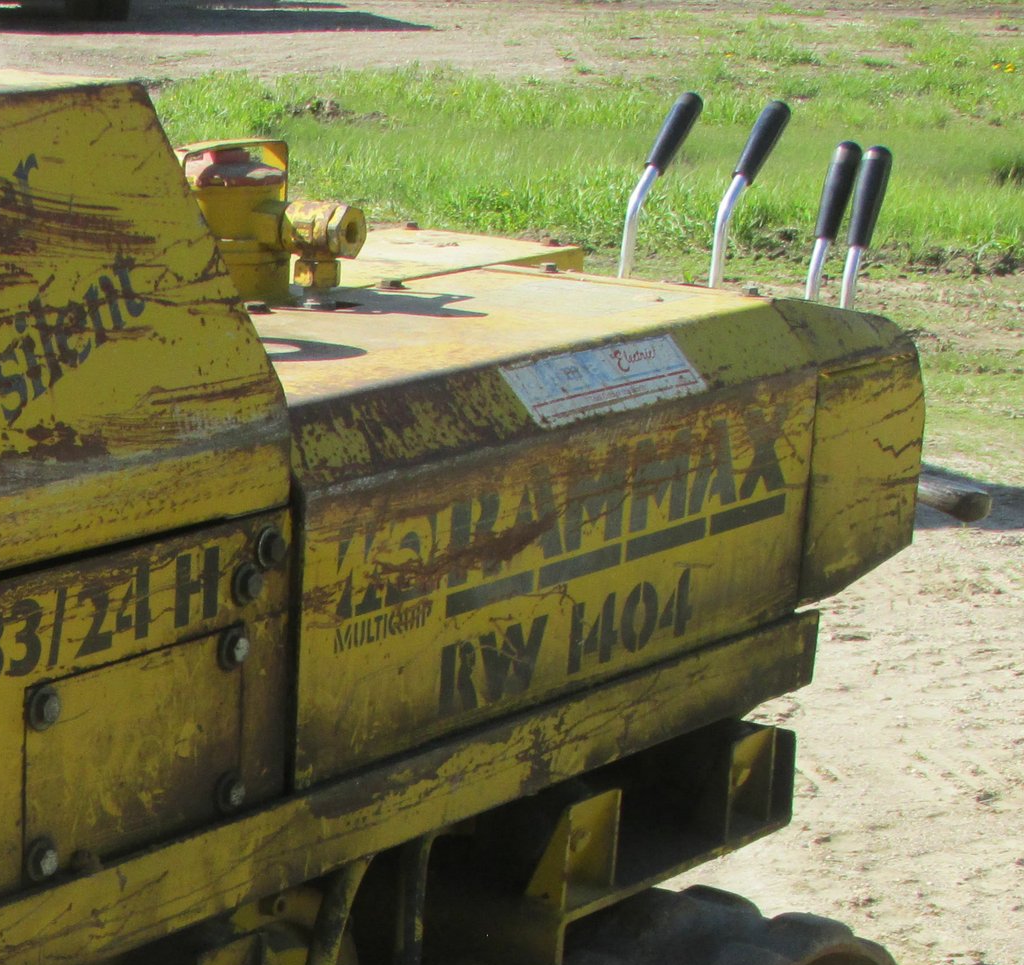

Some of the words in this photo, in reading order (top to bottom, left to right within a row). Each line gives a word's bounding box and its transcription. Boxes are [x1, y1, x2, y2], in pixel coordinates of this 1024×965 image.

[448, 405, 791, 588] RAMMAX
[174, 546, 220, 629] H
[438, 614, 549, 715] RW
[567, 568, 693, 676] 1404
